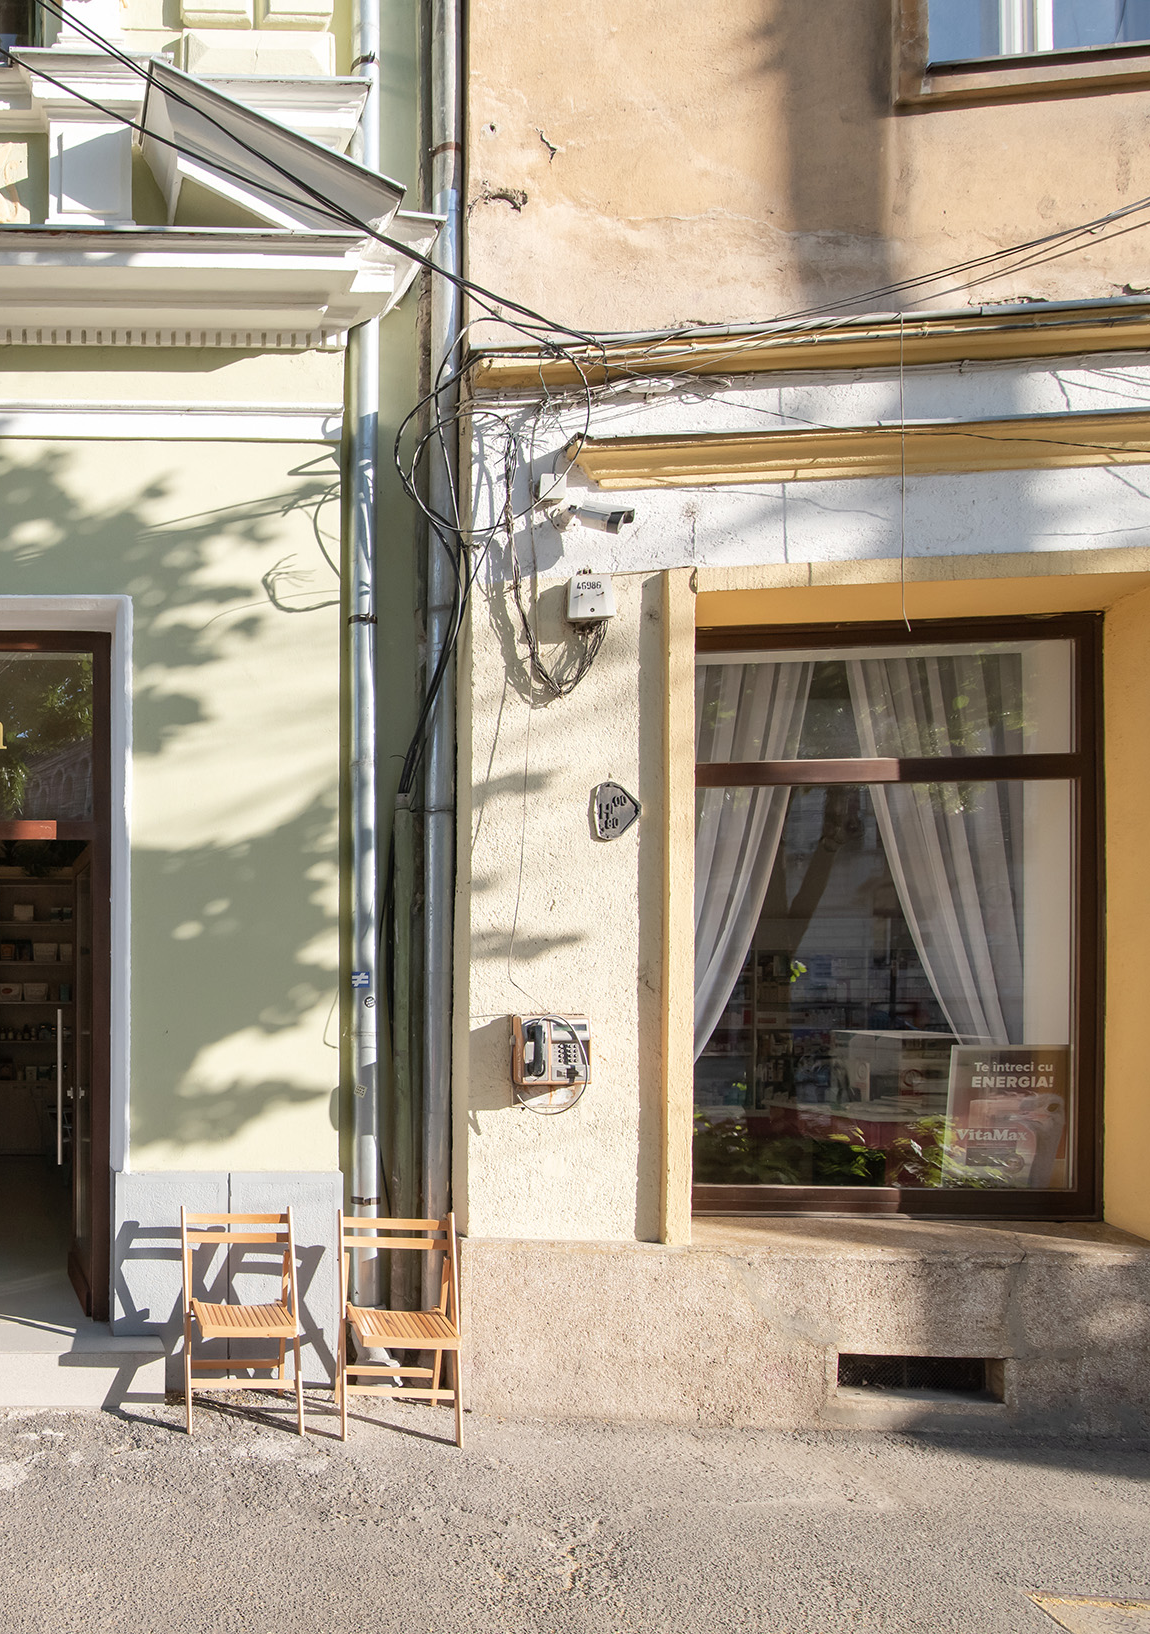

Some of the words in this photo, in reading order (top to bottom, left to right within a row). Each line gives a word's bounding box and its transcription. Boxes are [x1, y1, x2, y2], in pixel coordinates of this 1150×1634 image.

[974, 1062, 989, 1072] Te
[993, 1061, 1034, 1072] întreci
[1038, 1063, 1053, 1072] cu
[971, 1076, 1054, 1088] ENERGIA!
[956, 1128, 1028, 1141] VitaMax
